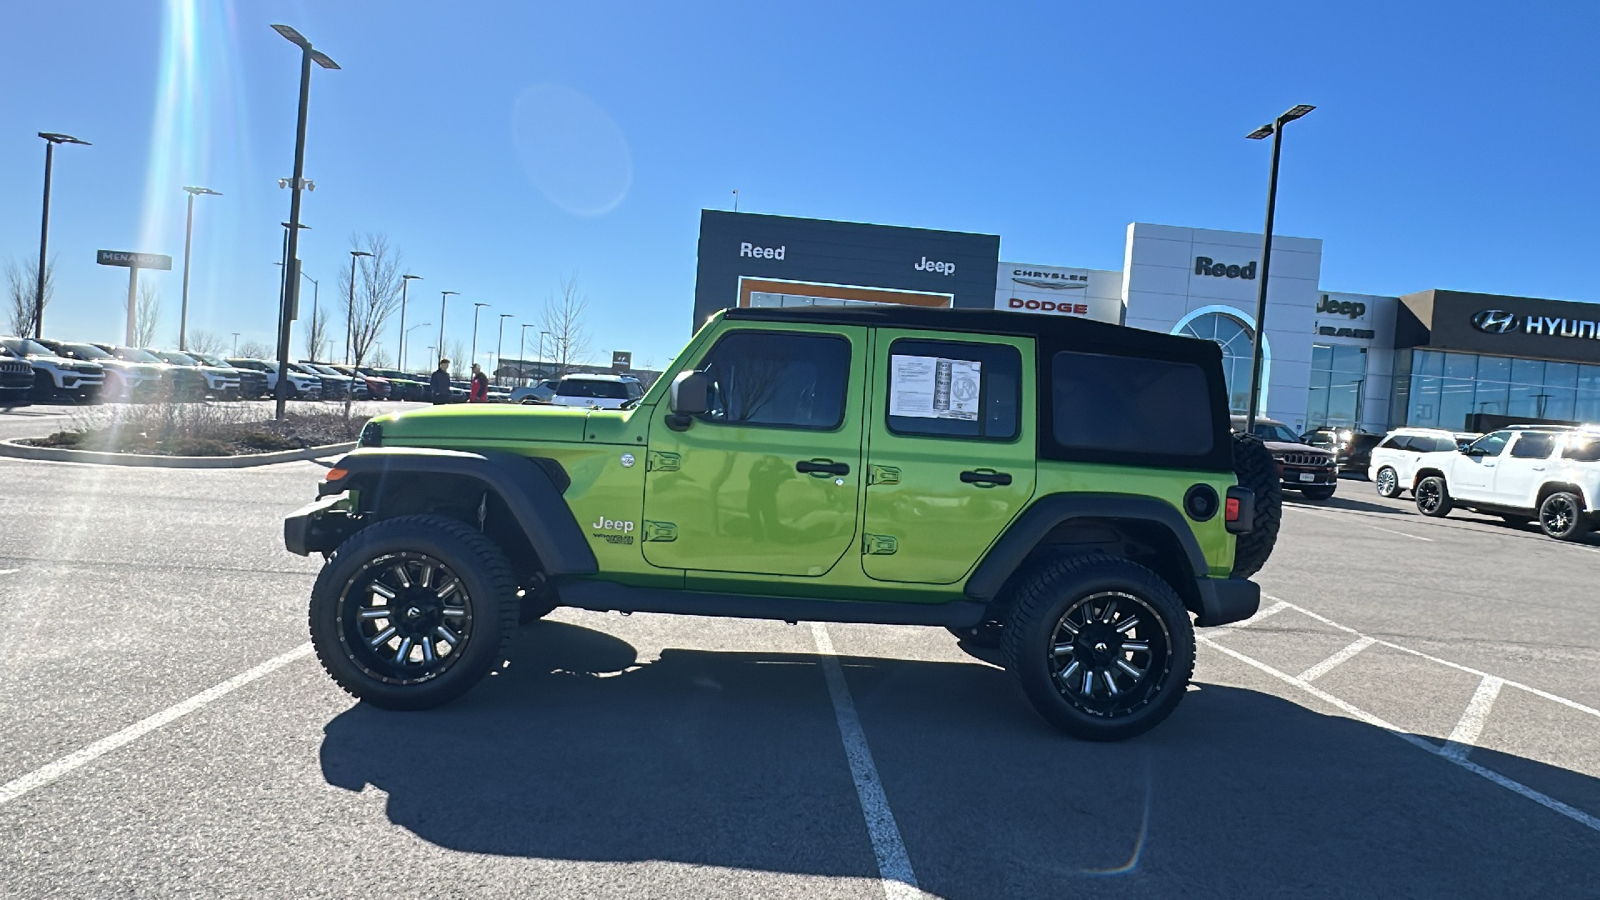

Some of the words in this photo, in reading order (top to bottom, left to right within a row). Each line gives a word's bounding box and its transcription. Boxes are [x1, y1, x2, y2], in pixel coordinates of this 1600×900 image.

[740, 242, 786, 260] Reed
[914, 256, 956, 276] Jeep
[1195, 256, 1257, 280] Reed
[1013, 269, 1088, 282] CHRYSLER
[1008, 298, 1088, 314] DODGE
[1316, 294, 1366, 319] Jeep
[1319, 326, 1375, 339] RAM
[1526, 315, 1600, 340] HYUN
[592, 516, 634, 533] Jeep
